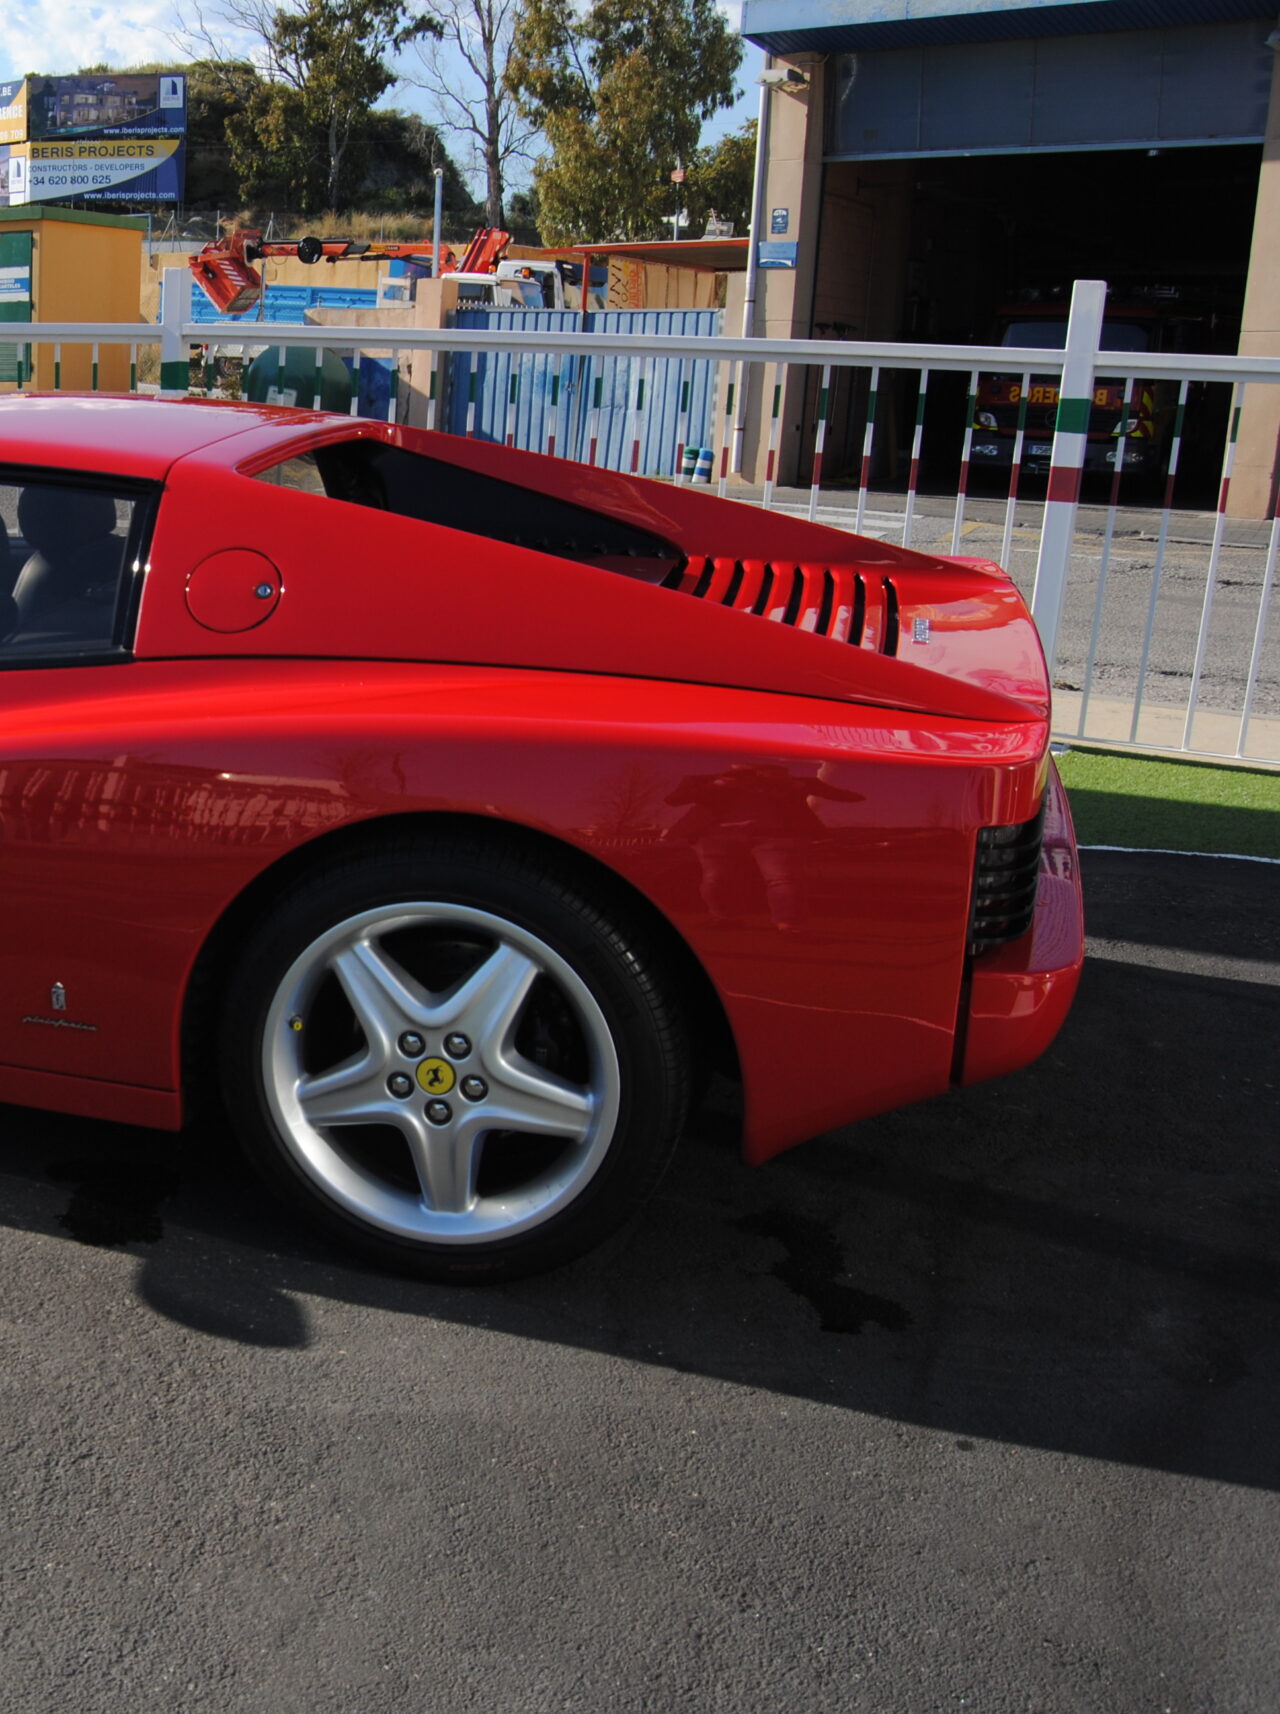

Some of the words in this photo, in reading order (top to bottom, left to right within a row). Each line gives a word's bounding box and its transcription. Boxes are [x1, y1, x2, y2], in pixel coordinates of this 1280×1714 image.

[31, 146, 74, 158] BERIS
[78, 145, 154, 157] PROJECTS
[94, 163, 145, 171] DEVELOPERS
[48, 175, 67, 185] 620
[70, 175, 89, 185] 800
[92, 174, 111, 184] 625
[83, 191, 176, 200] www.iberisprojects.com
